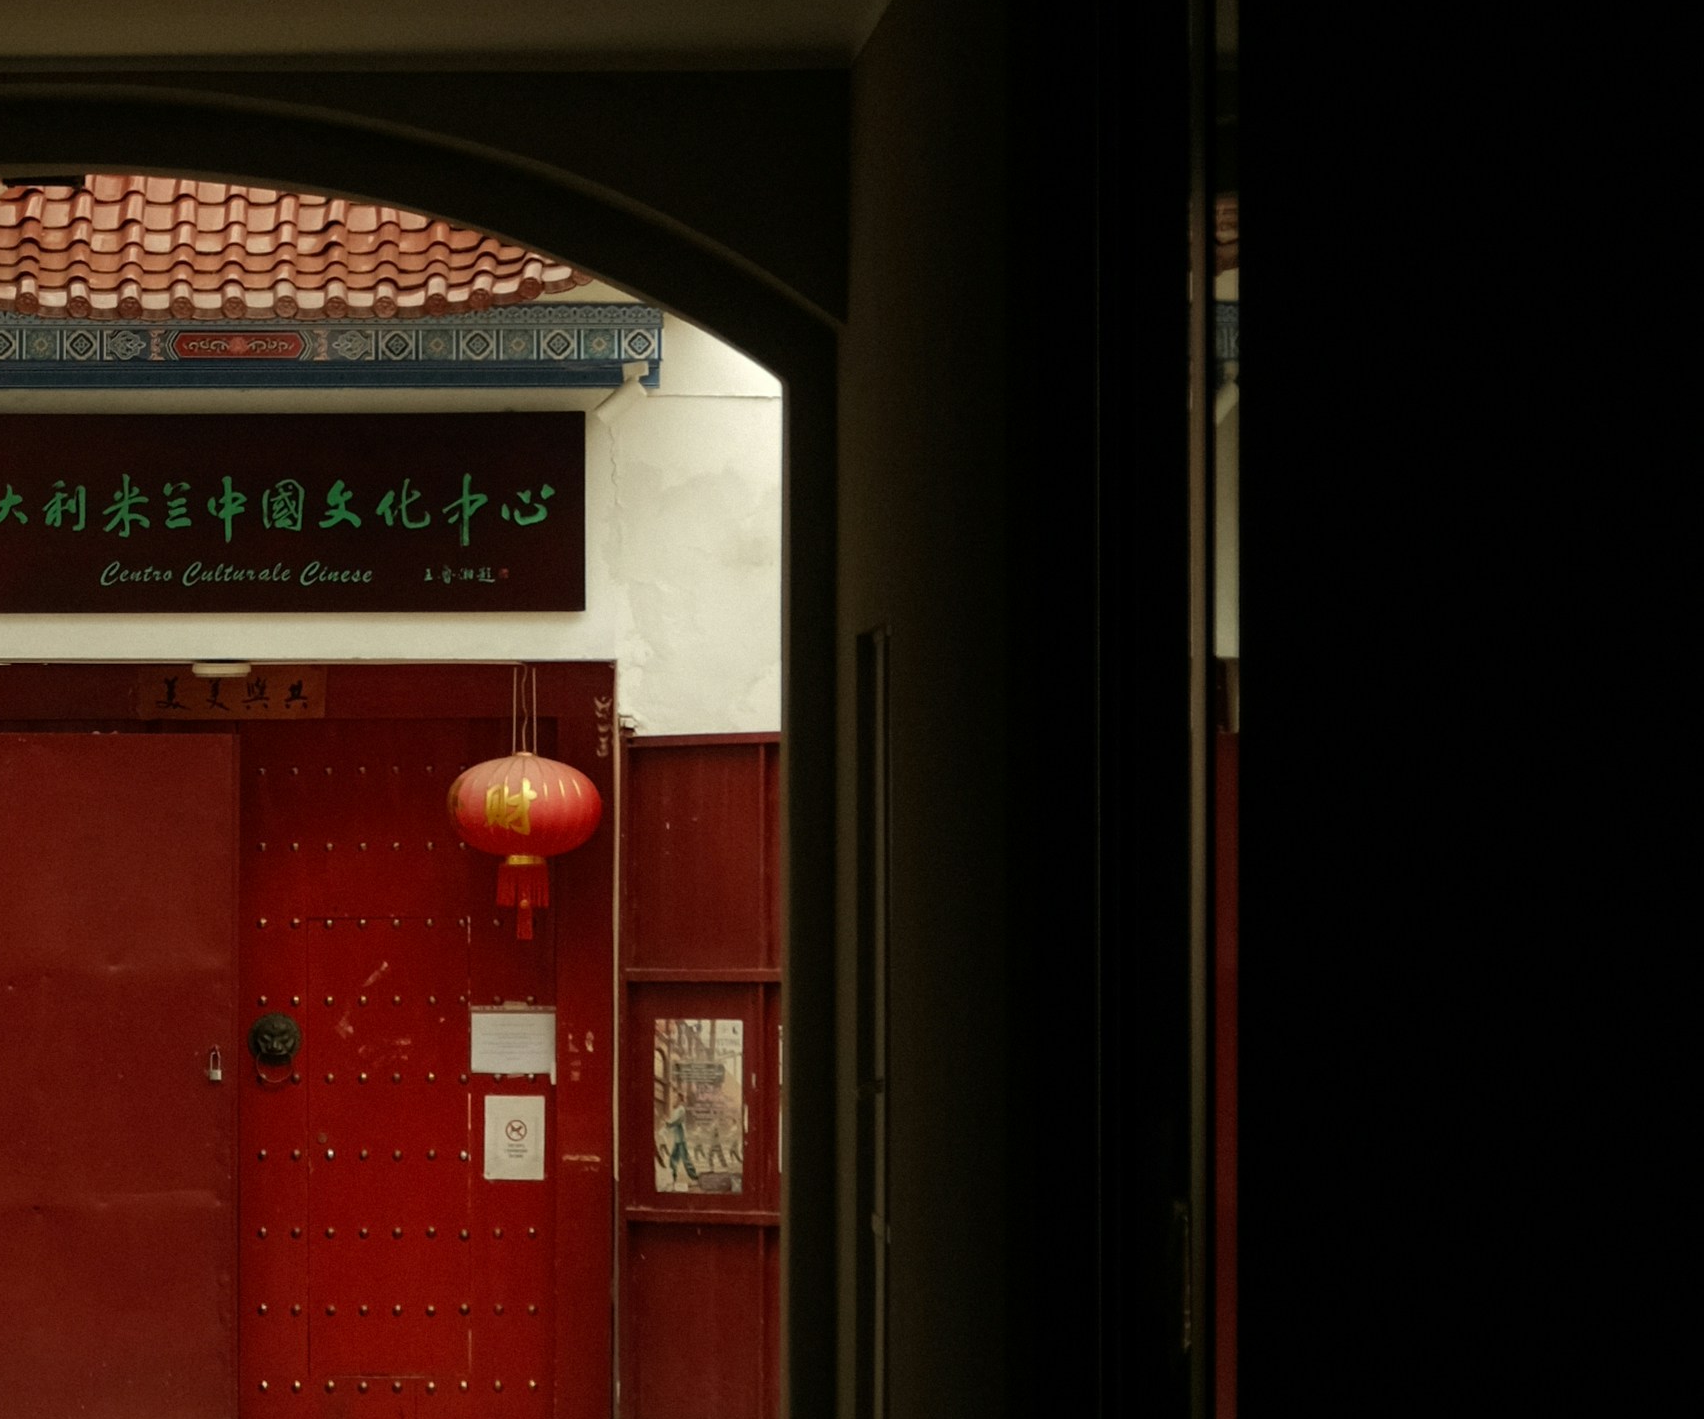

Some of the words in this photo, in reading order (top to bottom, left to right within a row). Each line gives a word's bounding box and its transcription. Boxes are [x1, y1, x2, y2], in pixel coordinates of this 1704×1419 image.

[100, 561, 173, 587] Centro
[182, 561, 292, 587] Culturale
[299, 561, 374, 587] Cinese
